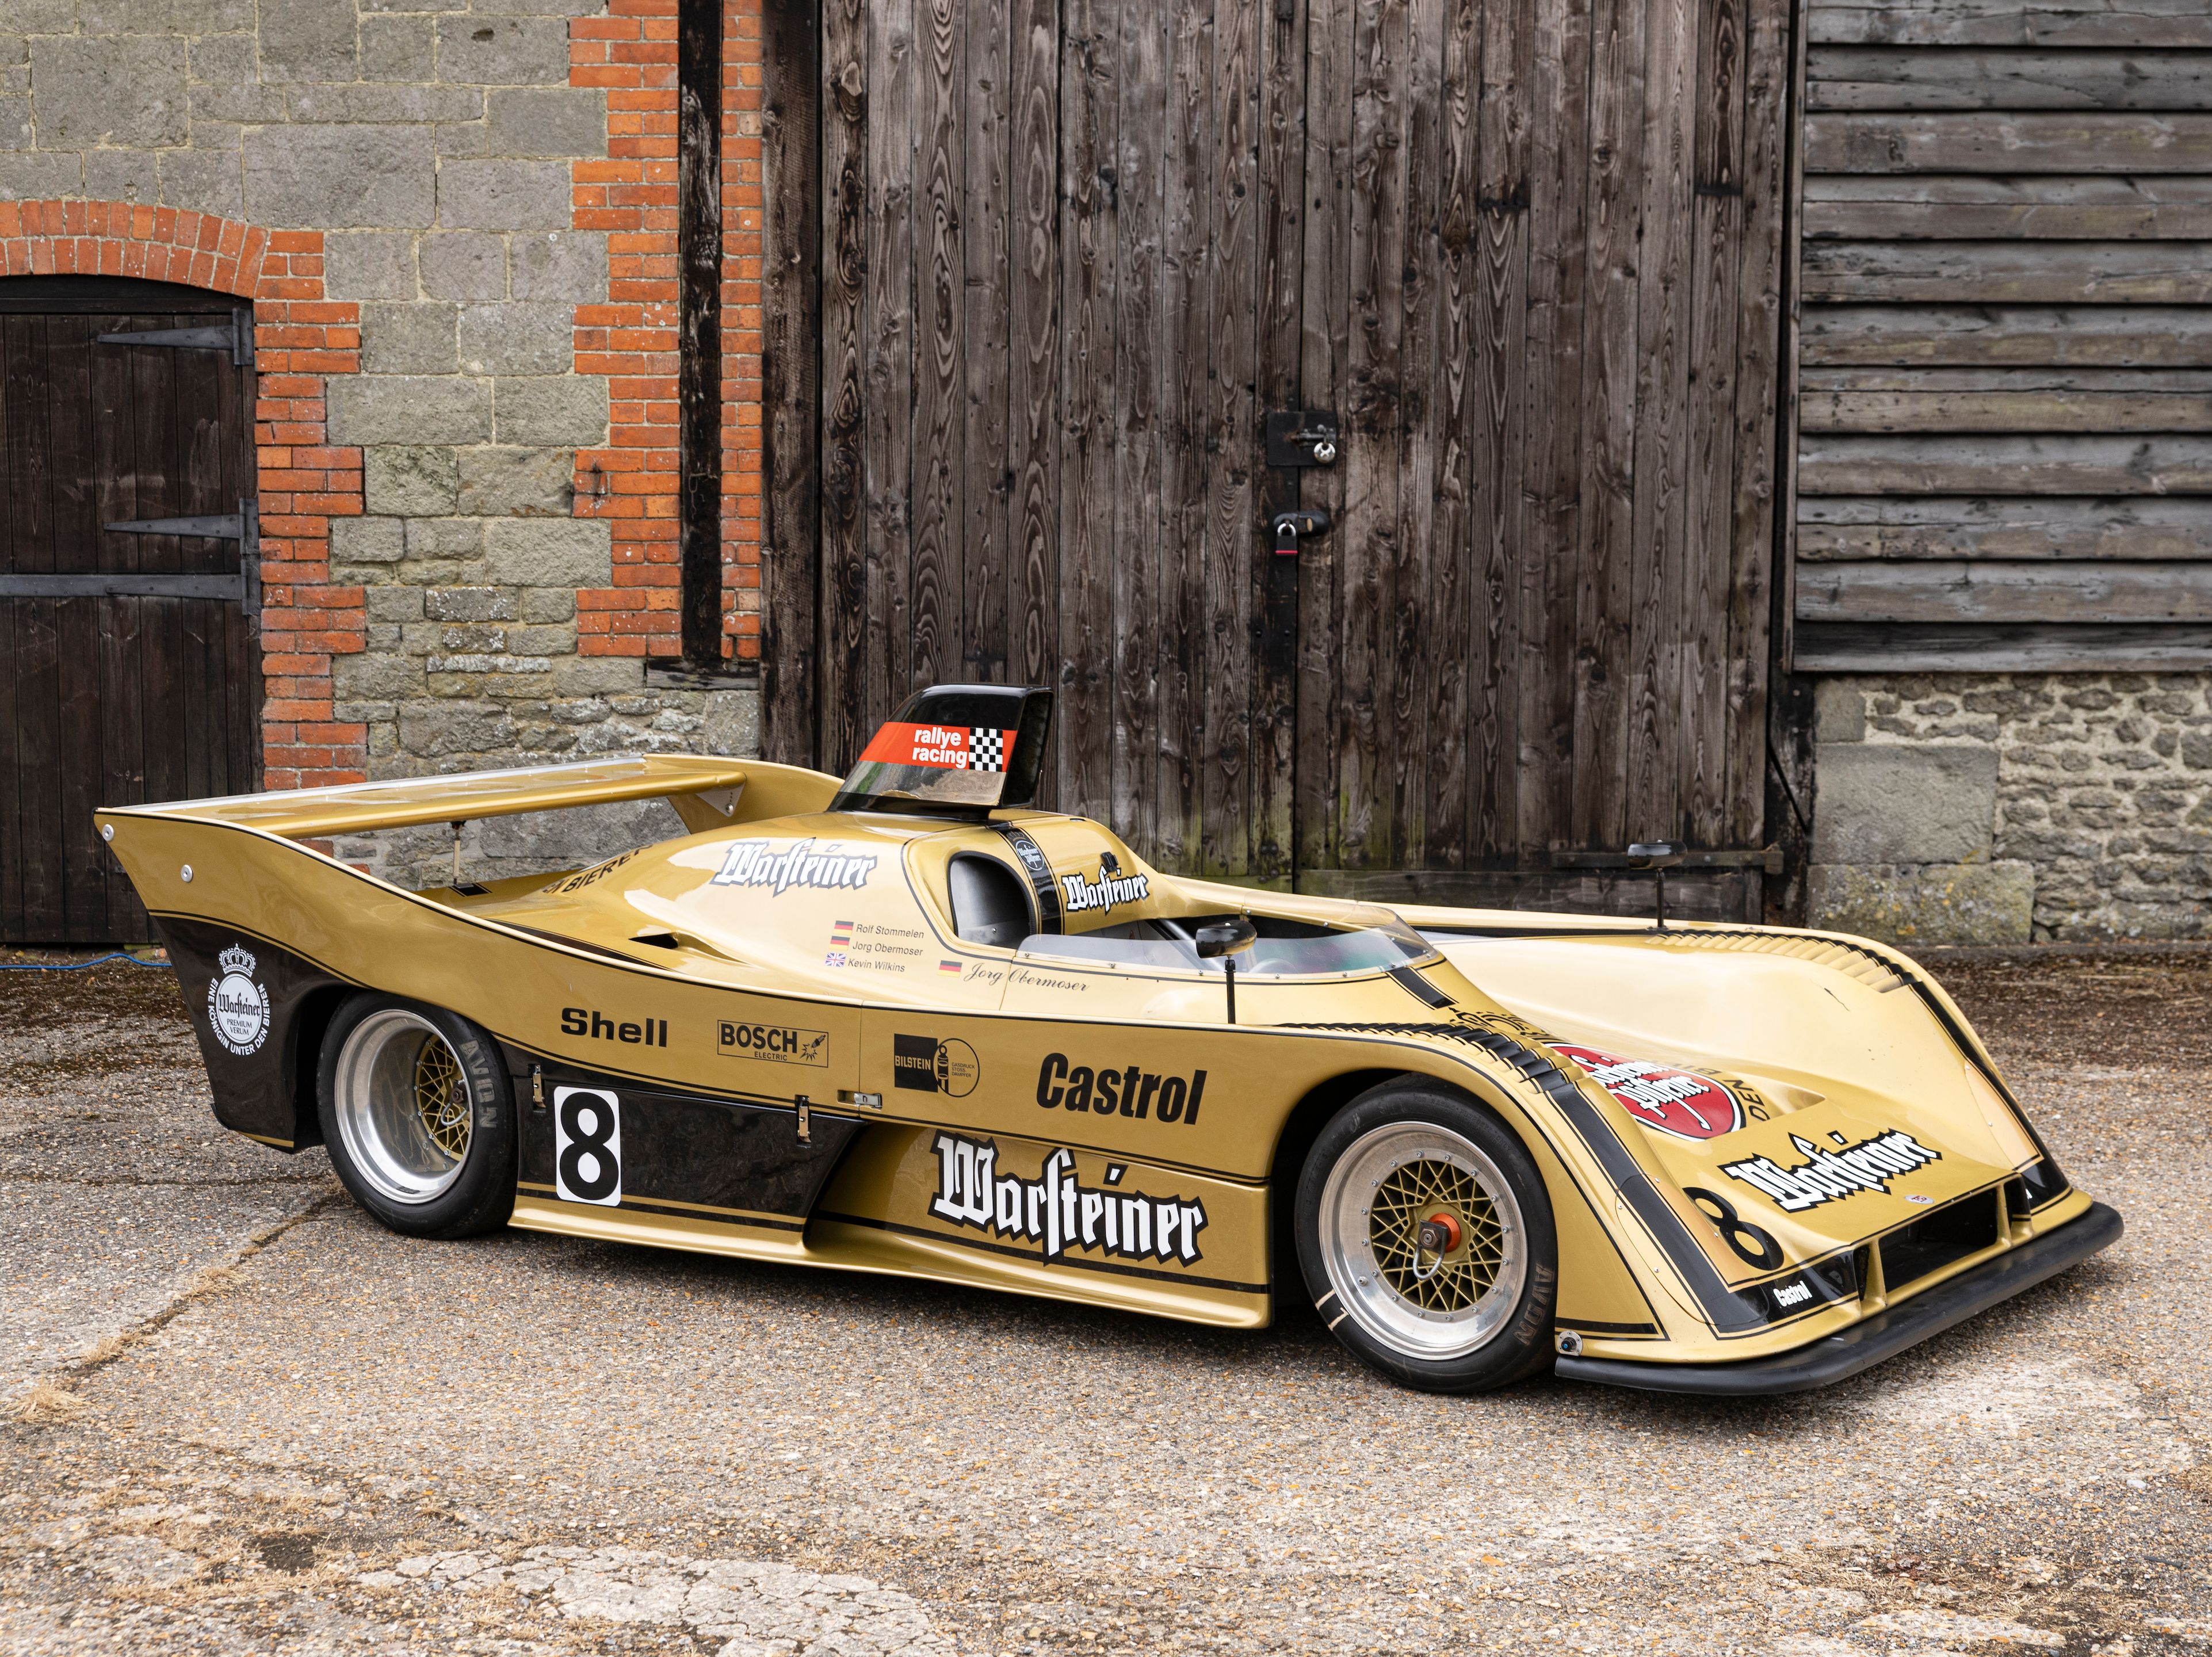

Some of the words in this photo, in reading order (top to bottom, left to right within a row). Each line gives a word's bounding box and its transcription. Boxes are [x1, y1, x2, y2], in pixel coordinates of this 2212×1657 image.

[914, 727, 962, 749] rallye
[912, 747, 968, 769] racing
[856, 924, 874, 934] Rolf
[875, 926, 924, 939] Stommelen
[853, 941, 872, 953] Jorg
[874, 943, 923, 956] Obermoser
[848, 959, 872, 969] Kevin
[875, 961, 906, 972] Wilkins
[964, 963, 1003, 986] Jorg
[1008, 968, 1091, 991] Obermoser
[208, 978, 219, 1003] EINE
[257, 983, 270, 1027] BIEREN
[227, 1018, 253, 1029] PREMIUM
[230, 1026, 249, 1036] VERUM
[561, 1007, 667, 1048] Shell
[230, 1044, 255, 1056] UNTER
[254, 1029, 268, 1048] DEN
[721, 1023, 797, 1053] BOSCH
[754, 1051, 788, 1062] ELECTRIC
[895, 1055, 931, 1070] BILSTEIN
[460, 1040, 498, 1129] AVON
[1036, 1052, 1207, 1125] Castrol
[1722, 1079, 1771, 1121] DEN
[560, 1091, 619, 1200] 8
[929, 1129, 1208, 1266] Warsteiner
[1683, 1187, 1785, 1270] 8
[1513, 1263, 1554, 1345] AVON
[1773, 1280, 1813, 1307] Castrol
